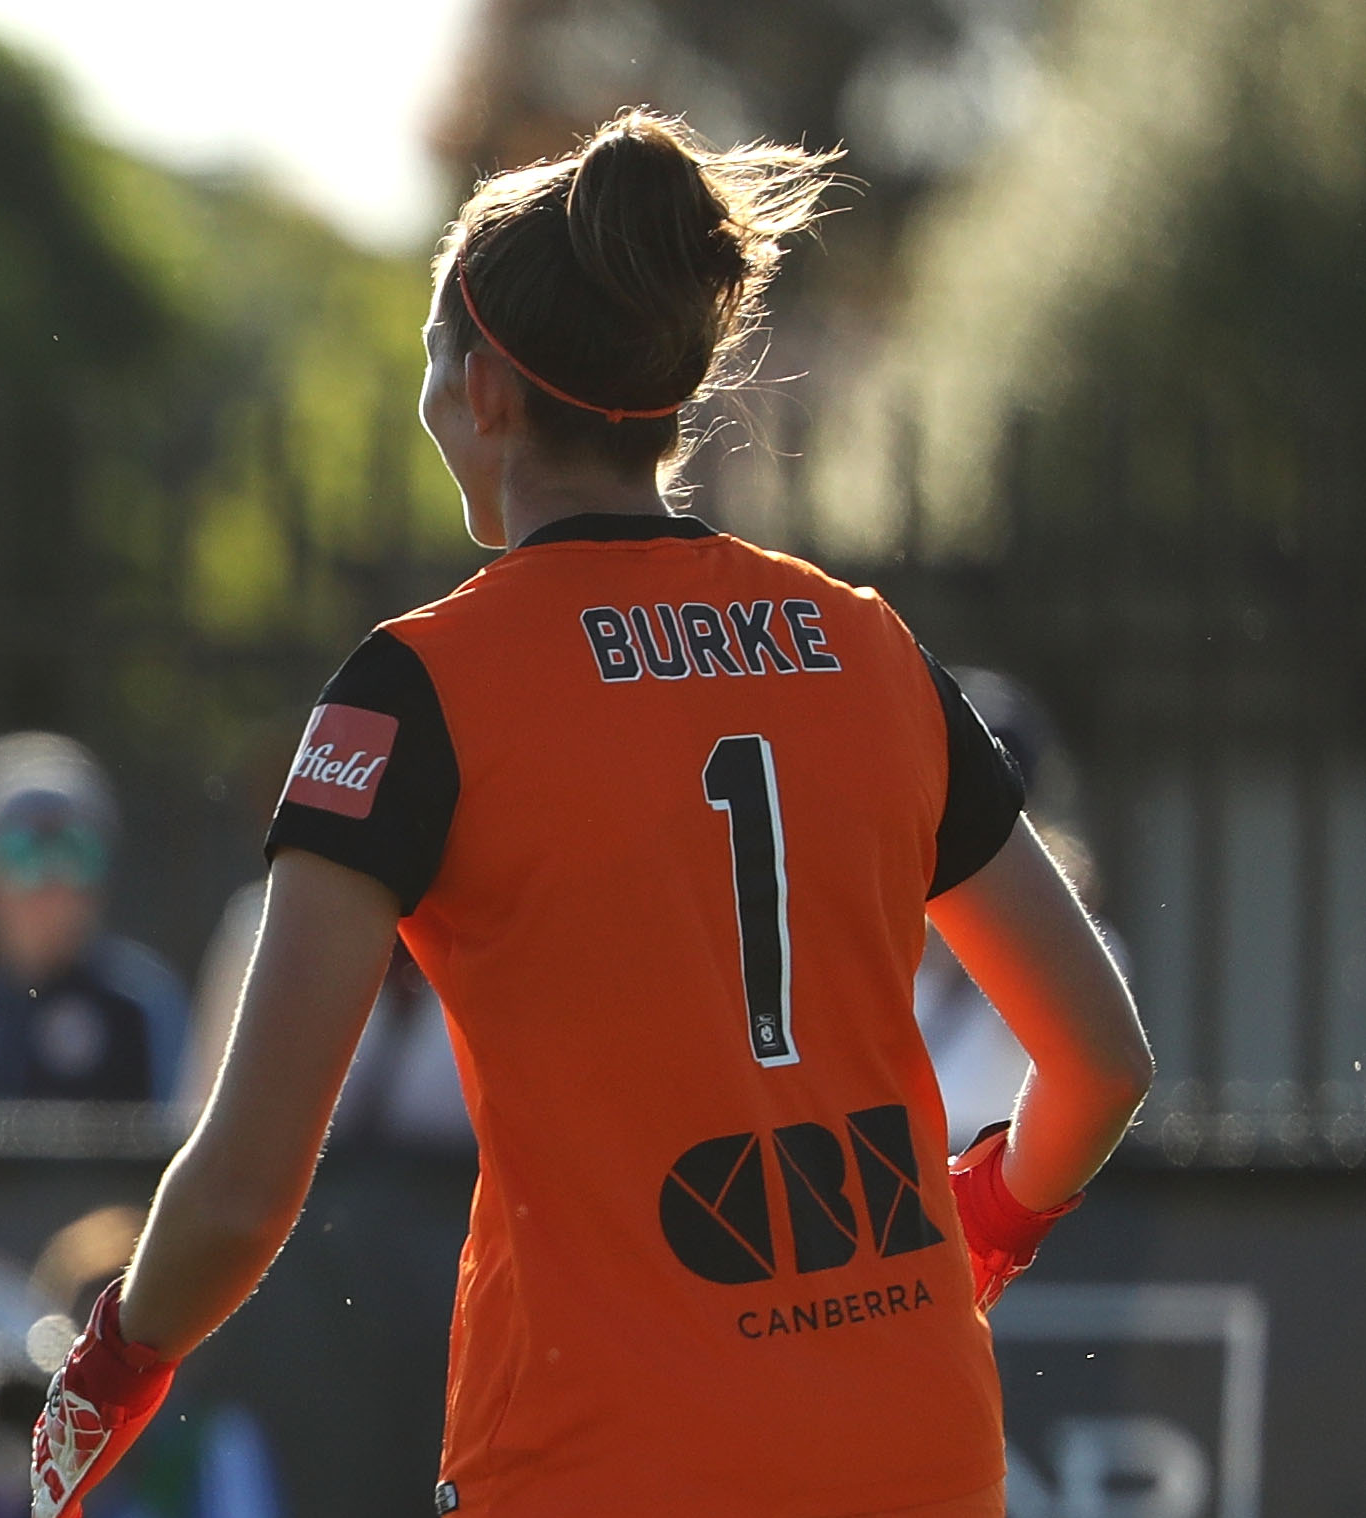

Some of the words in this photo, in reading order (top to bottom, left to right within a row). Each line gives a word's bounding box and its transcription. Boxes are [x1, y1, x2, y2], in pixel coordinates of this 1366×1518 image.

[580, 599, 842, 683] BURKE
[702, 734, 800, 1068] 1
[737, 1279, 934, 1340] CANBERRA
